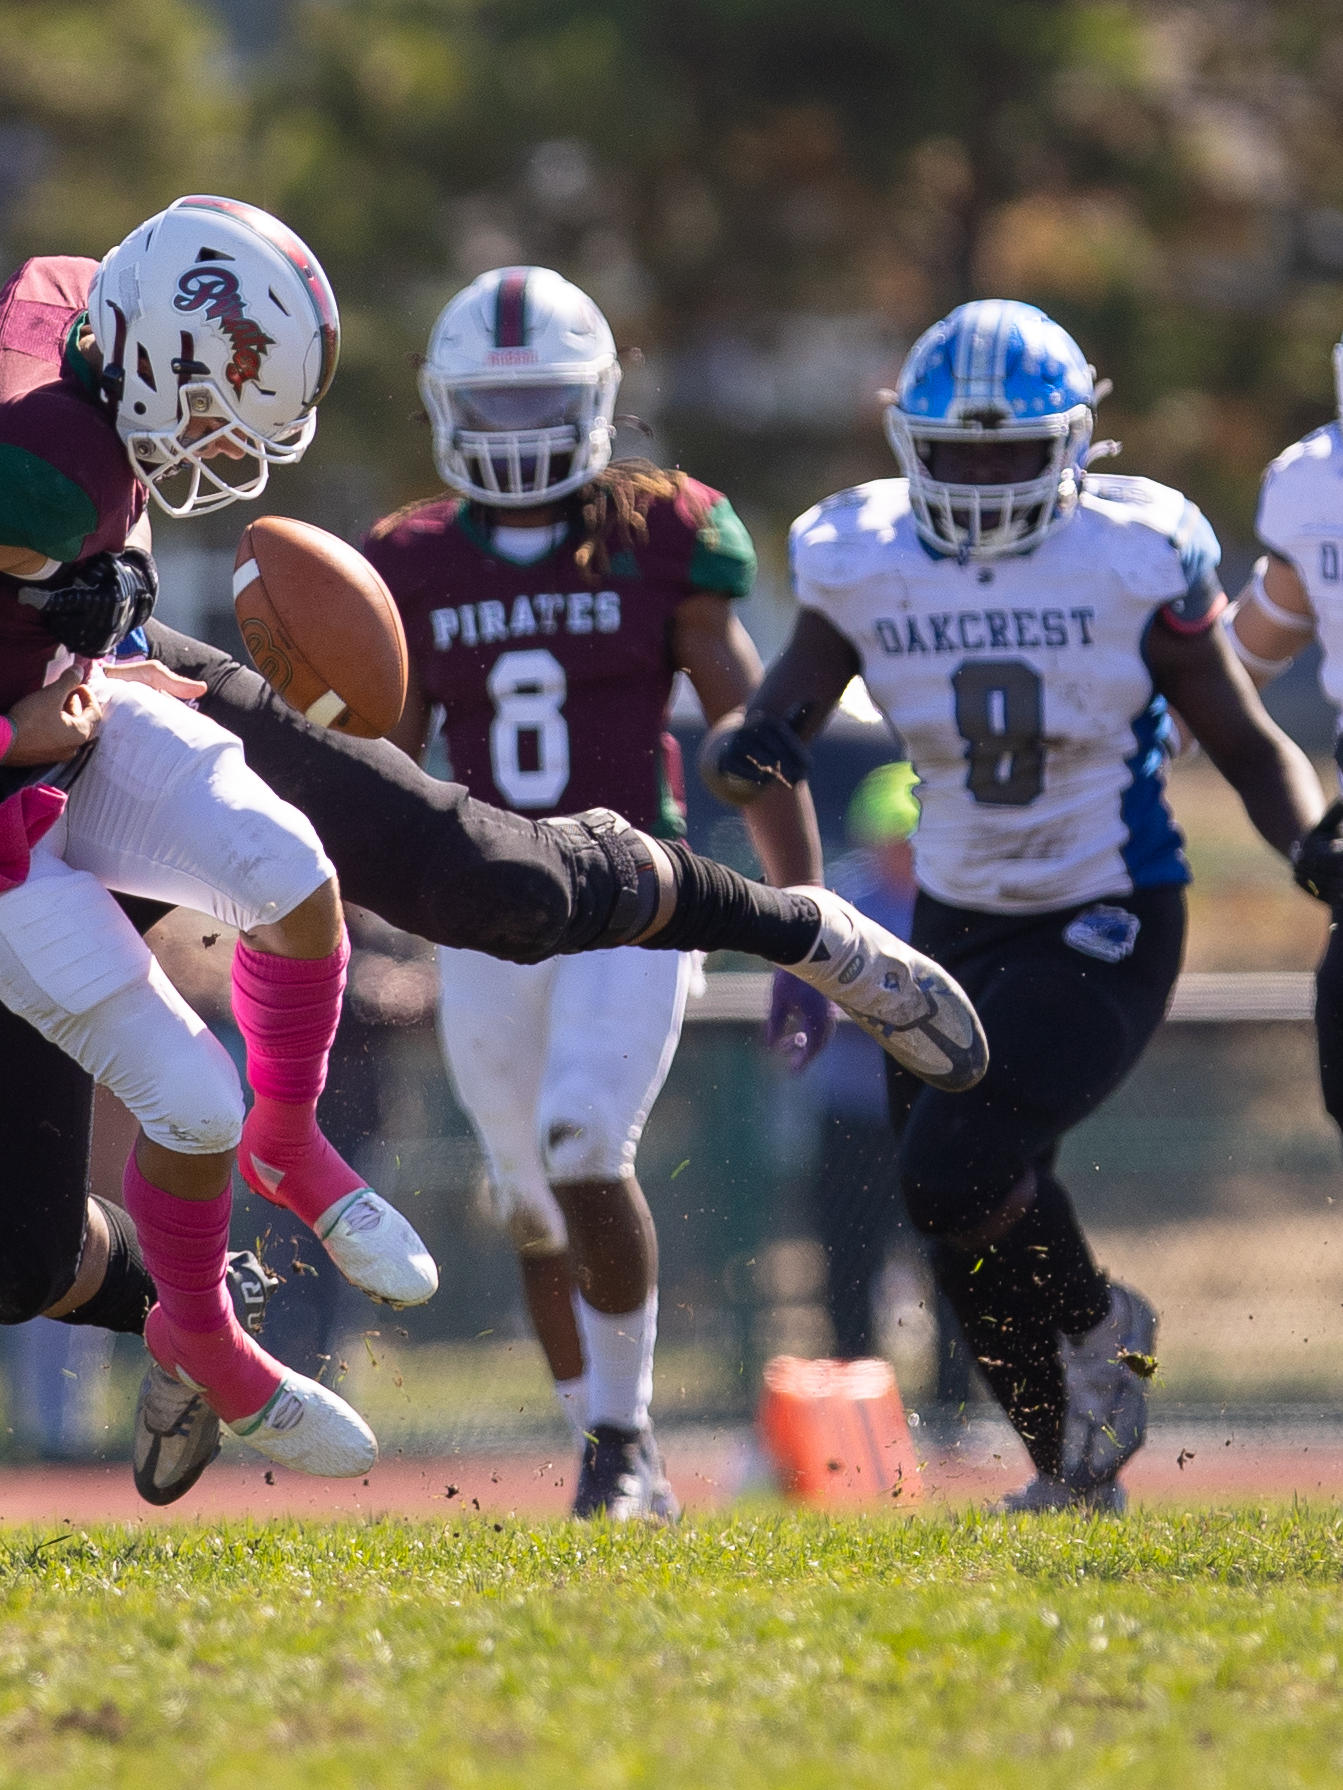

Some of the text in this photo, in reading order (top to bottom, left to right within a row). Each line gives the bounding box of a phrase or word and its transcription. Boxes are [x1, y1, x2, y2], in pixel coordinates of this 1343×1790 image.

[431, 590, 622, 651] PIRATES
[874, 606, 1096, 656] OAKCREST
[487, 648, 570, 809] 8
[951, 655, 1046, 807] 8
